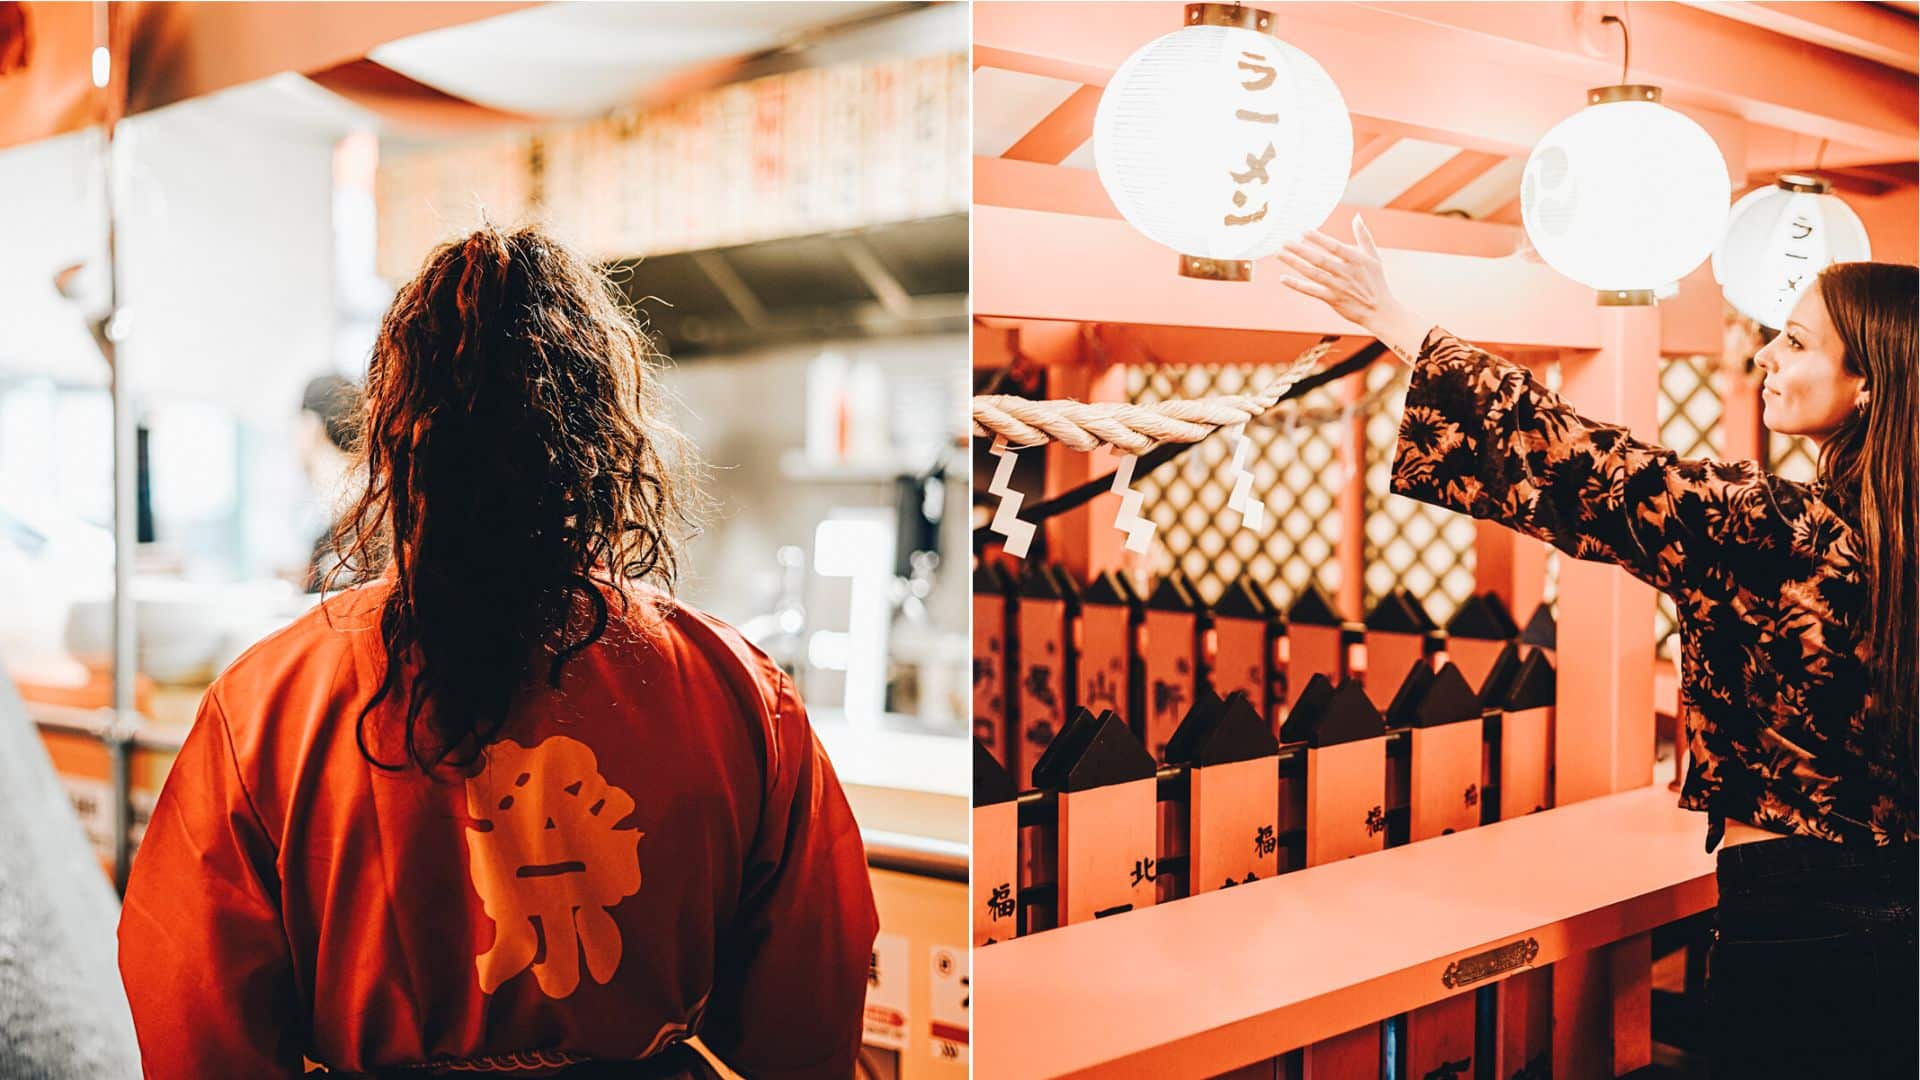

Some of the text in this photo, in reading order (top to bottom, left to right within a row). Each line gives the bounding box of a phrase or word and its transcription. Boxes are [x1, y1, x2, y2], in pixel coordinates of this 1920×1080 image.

[1223, 50, 1280, 227] ラーメン
[1364, 805, 1386, 838] 福
[1254, 824, 1277, 859] 福
[465, 735, 646, 999] 祭
[1129, 857, 1158, 888] 北
[987, 882, 1016, 922] 福
